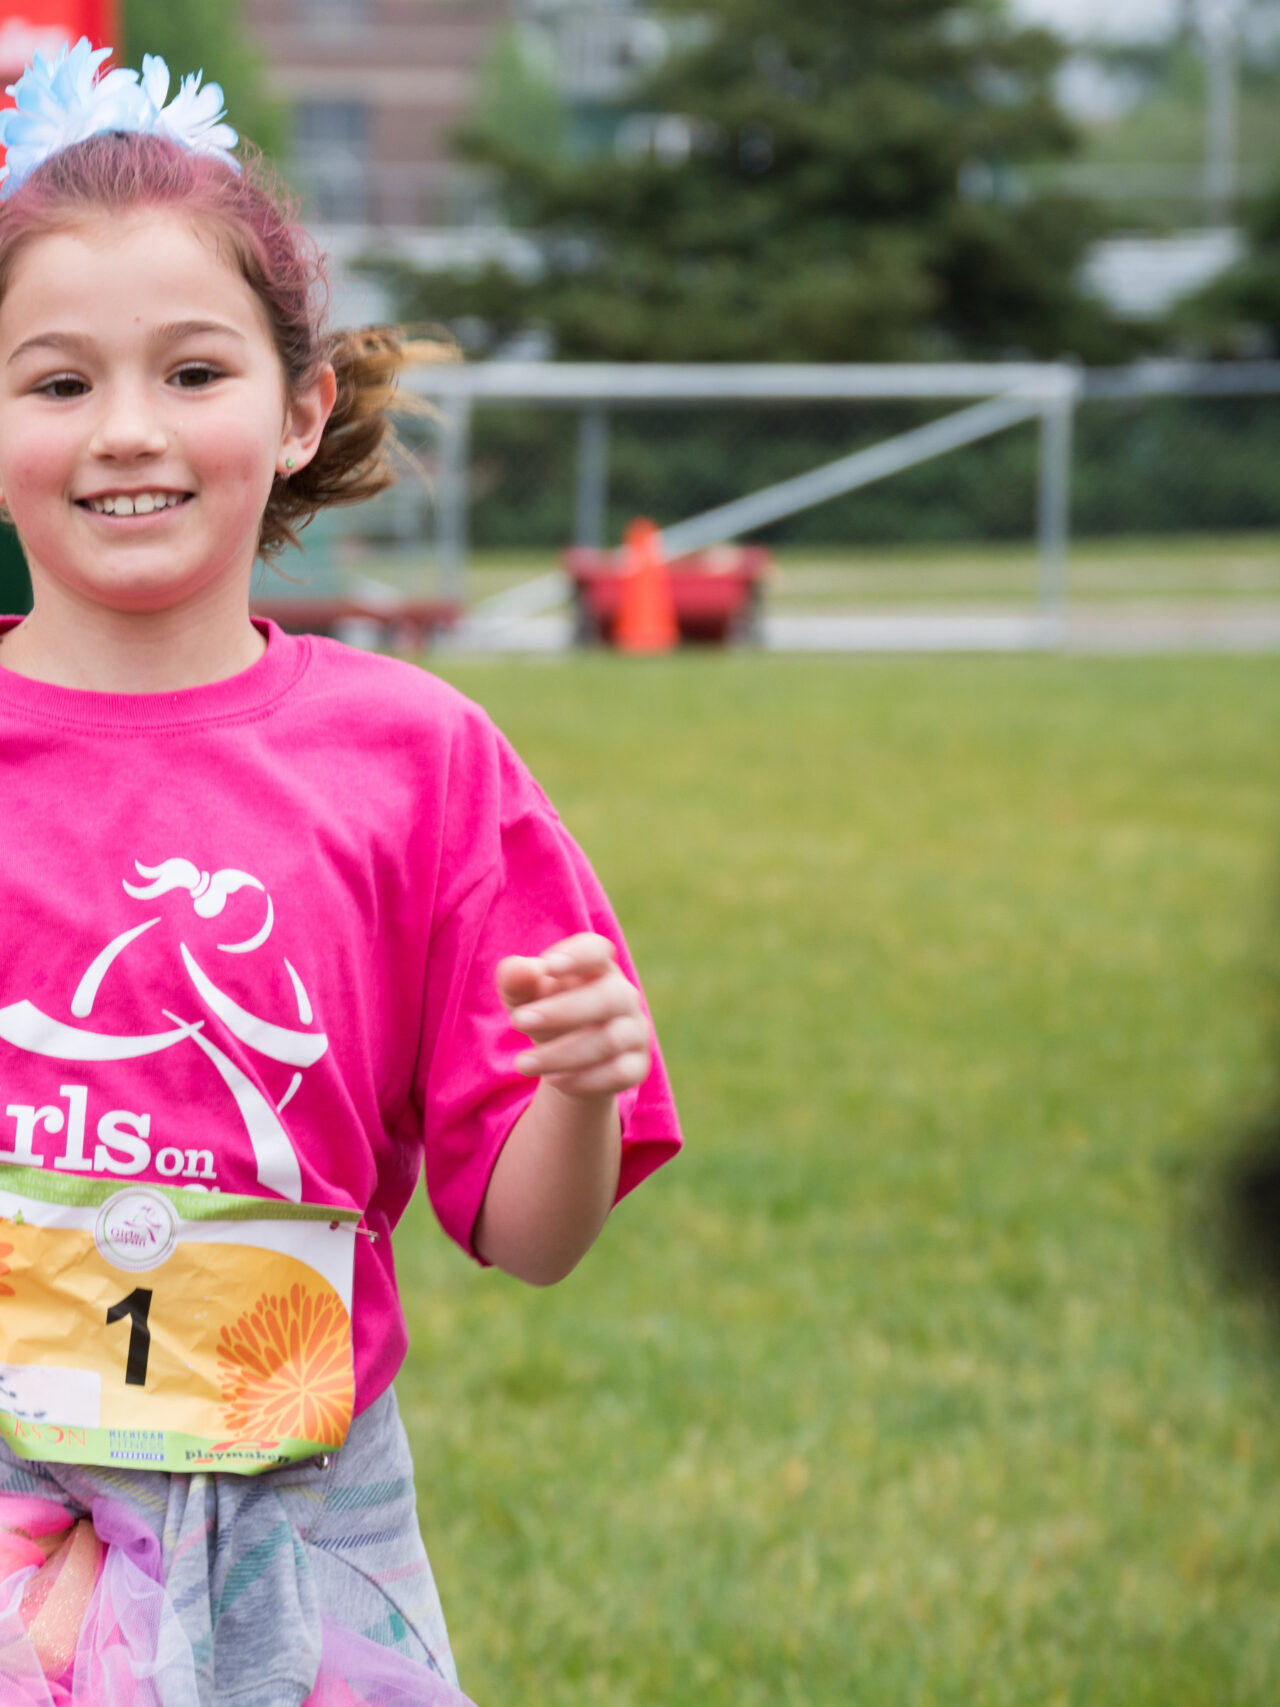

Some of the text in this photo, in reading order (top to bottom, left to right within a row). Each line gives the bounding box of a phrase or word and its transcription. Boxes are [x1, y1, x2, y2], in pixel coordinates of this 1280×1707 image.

[155, 1147, 217, 1180] on
[106, 1287, 153, 1387] 1
[109, 1430, 163, 1440] MICHIGAN
